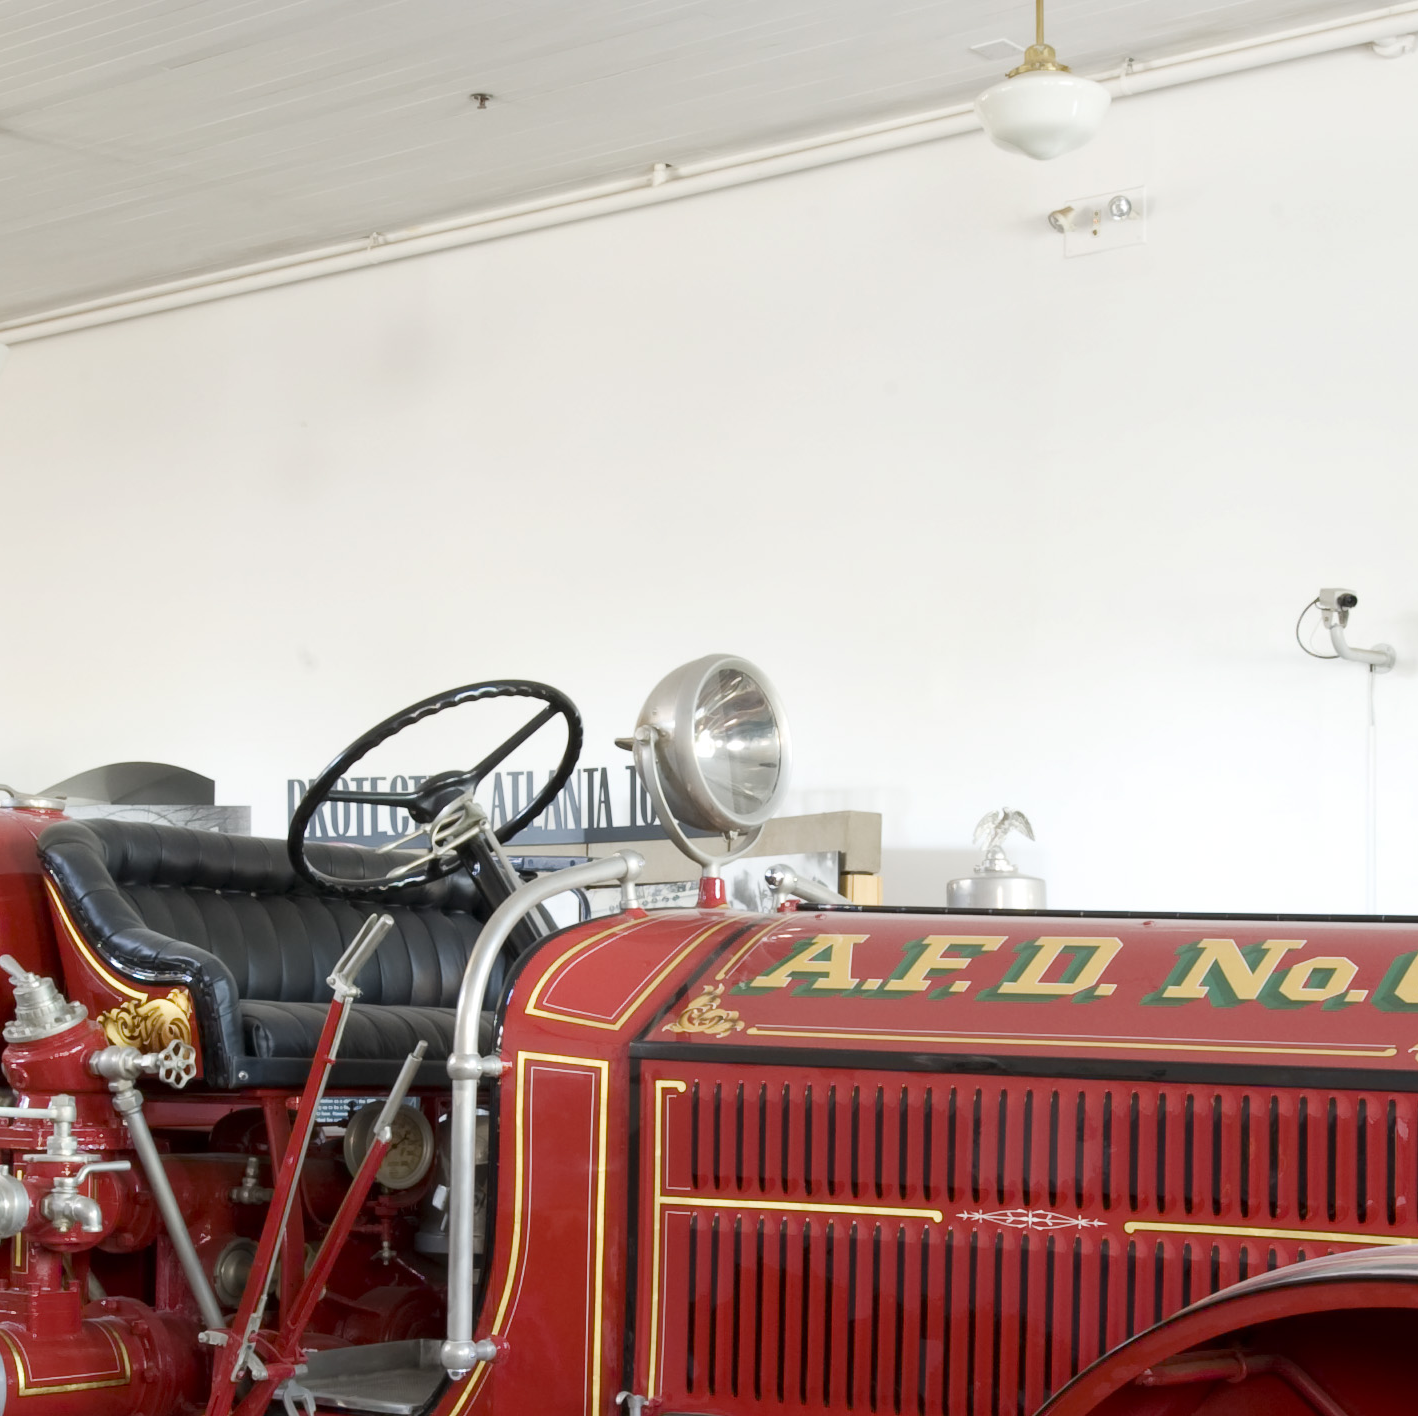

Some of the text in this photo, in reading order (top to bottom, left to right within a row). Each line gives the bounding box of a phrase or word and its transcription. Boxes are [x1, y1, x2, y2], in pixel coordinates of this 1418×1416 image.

[490, 767, 613, 831] ATLANTA
[737, 932, 1118, 1001] A.F.D.
[1147, 937, 1369, 1009] No.
